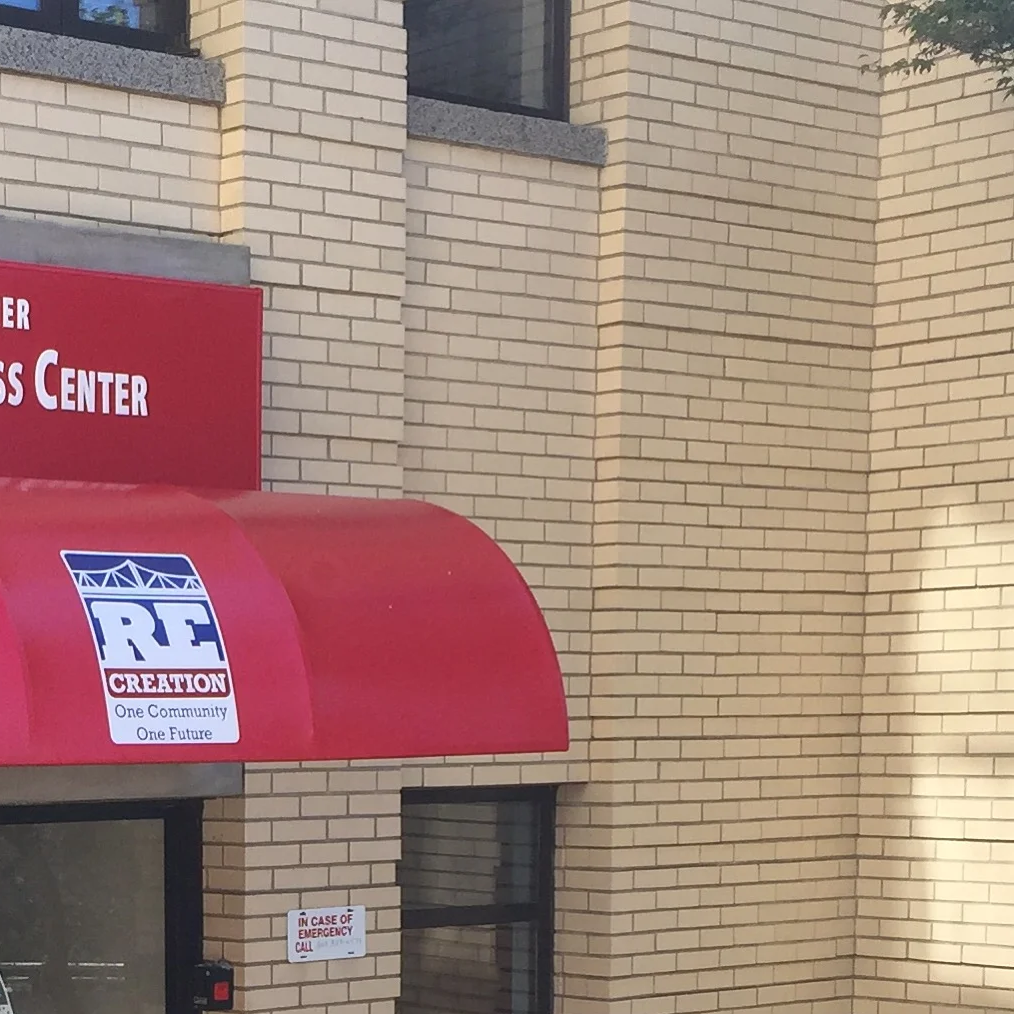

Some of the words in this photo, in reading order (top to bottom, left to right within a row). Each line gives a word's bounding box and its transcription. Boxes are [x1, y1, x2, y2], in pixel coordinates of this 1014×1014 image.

[34, 349, 149, 417] CENTER
[91, 601, 223, 662] RE
[109, 673, 226, 693] CREATION
[114, 704, 144, 718] One
[148, 704, 228, 721] Community
[136, 727, 166, 741] One
[169, 727, 213, 741] Future
[298, 917, 308, 927] IN
[311, 915, 337, 926] CASE
[340, 914, 353, 924] OF
[298, 926, 353, 939] EMERGENCY
[295, 941, 313, 953] CALL
